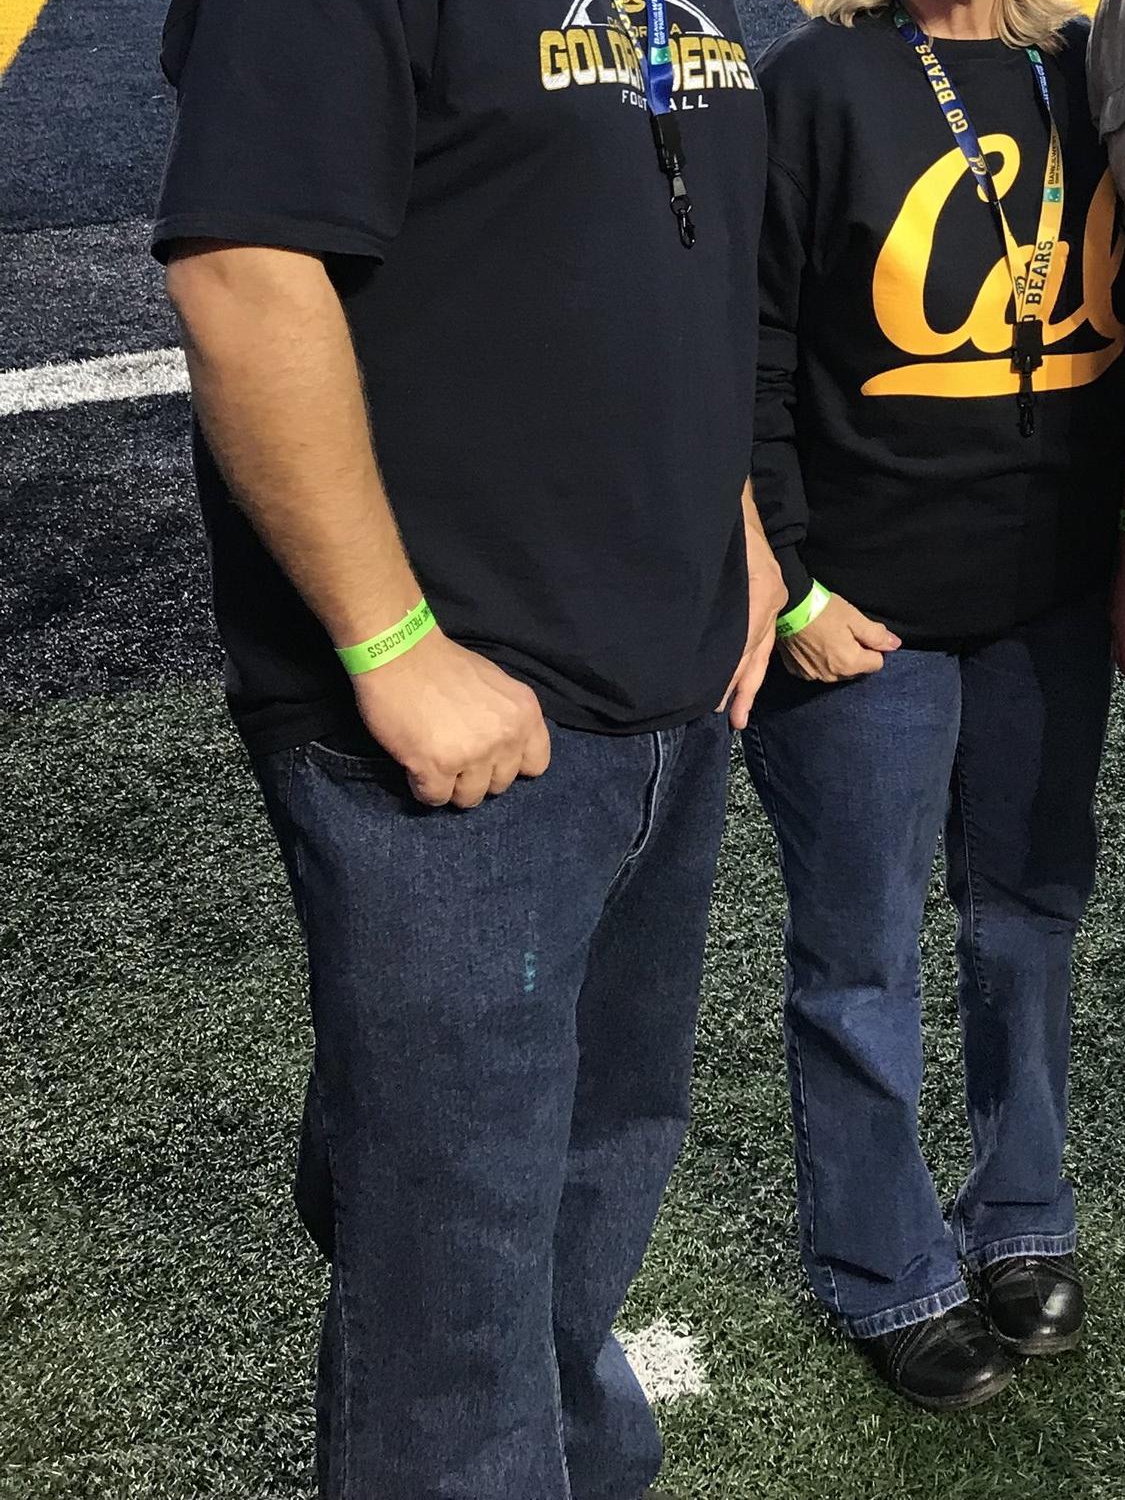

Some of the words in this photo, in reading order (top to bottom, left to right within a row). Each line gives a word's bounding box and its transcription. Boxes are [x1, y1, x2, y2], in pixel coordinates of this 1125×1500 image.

[915, 44, 957, 105] BEARS
[622, 89, 709, 110] FOOTALL
[946, 108, 969, 134] GO
[861, 133, 1125, 398] Cal
[1026, 240, 1054, 305] BEARS
[367, 630, 406, 659] ACCESS
